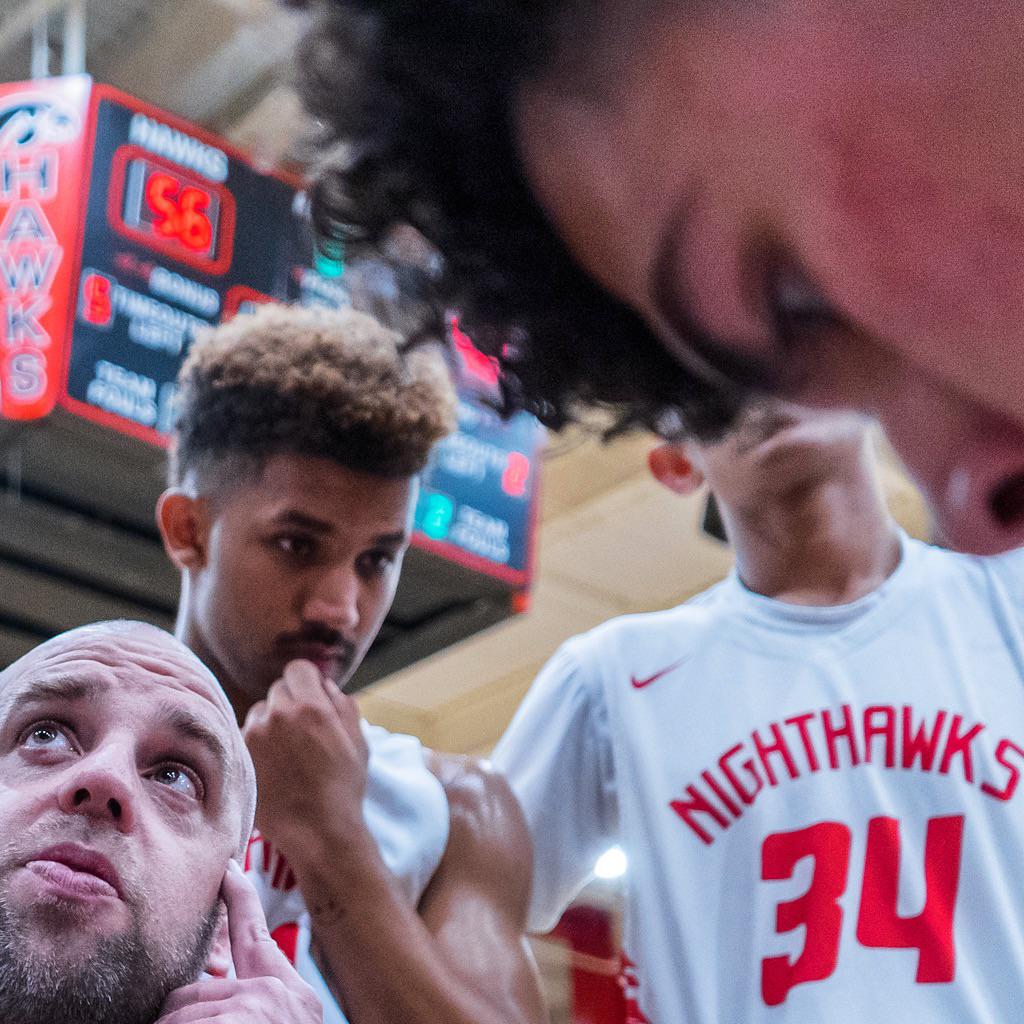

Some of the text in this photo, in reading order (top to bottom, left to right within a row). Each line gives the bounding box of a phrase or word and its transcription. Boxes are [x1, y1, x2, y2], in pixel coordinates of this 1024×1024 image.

[145, 171, 214, 253] 56
[668, 703, 1024, 846] NIGHTHAWKS
[760, 815, 966, 1007] 34
